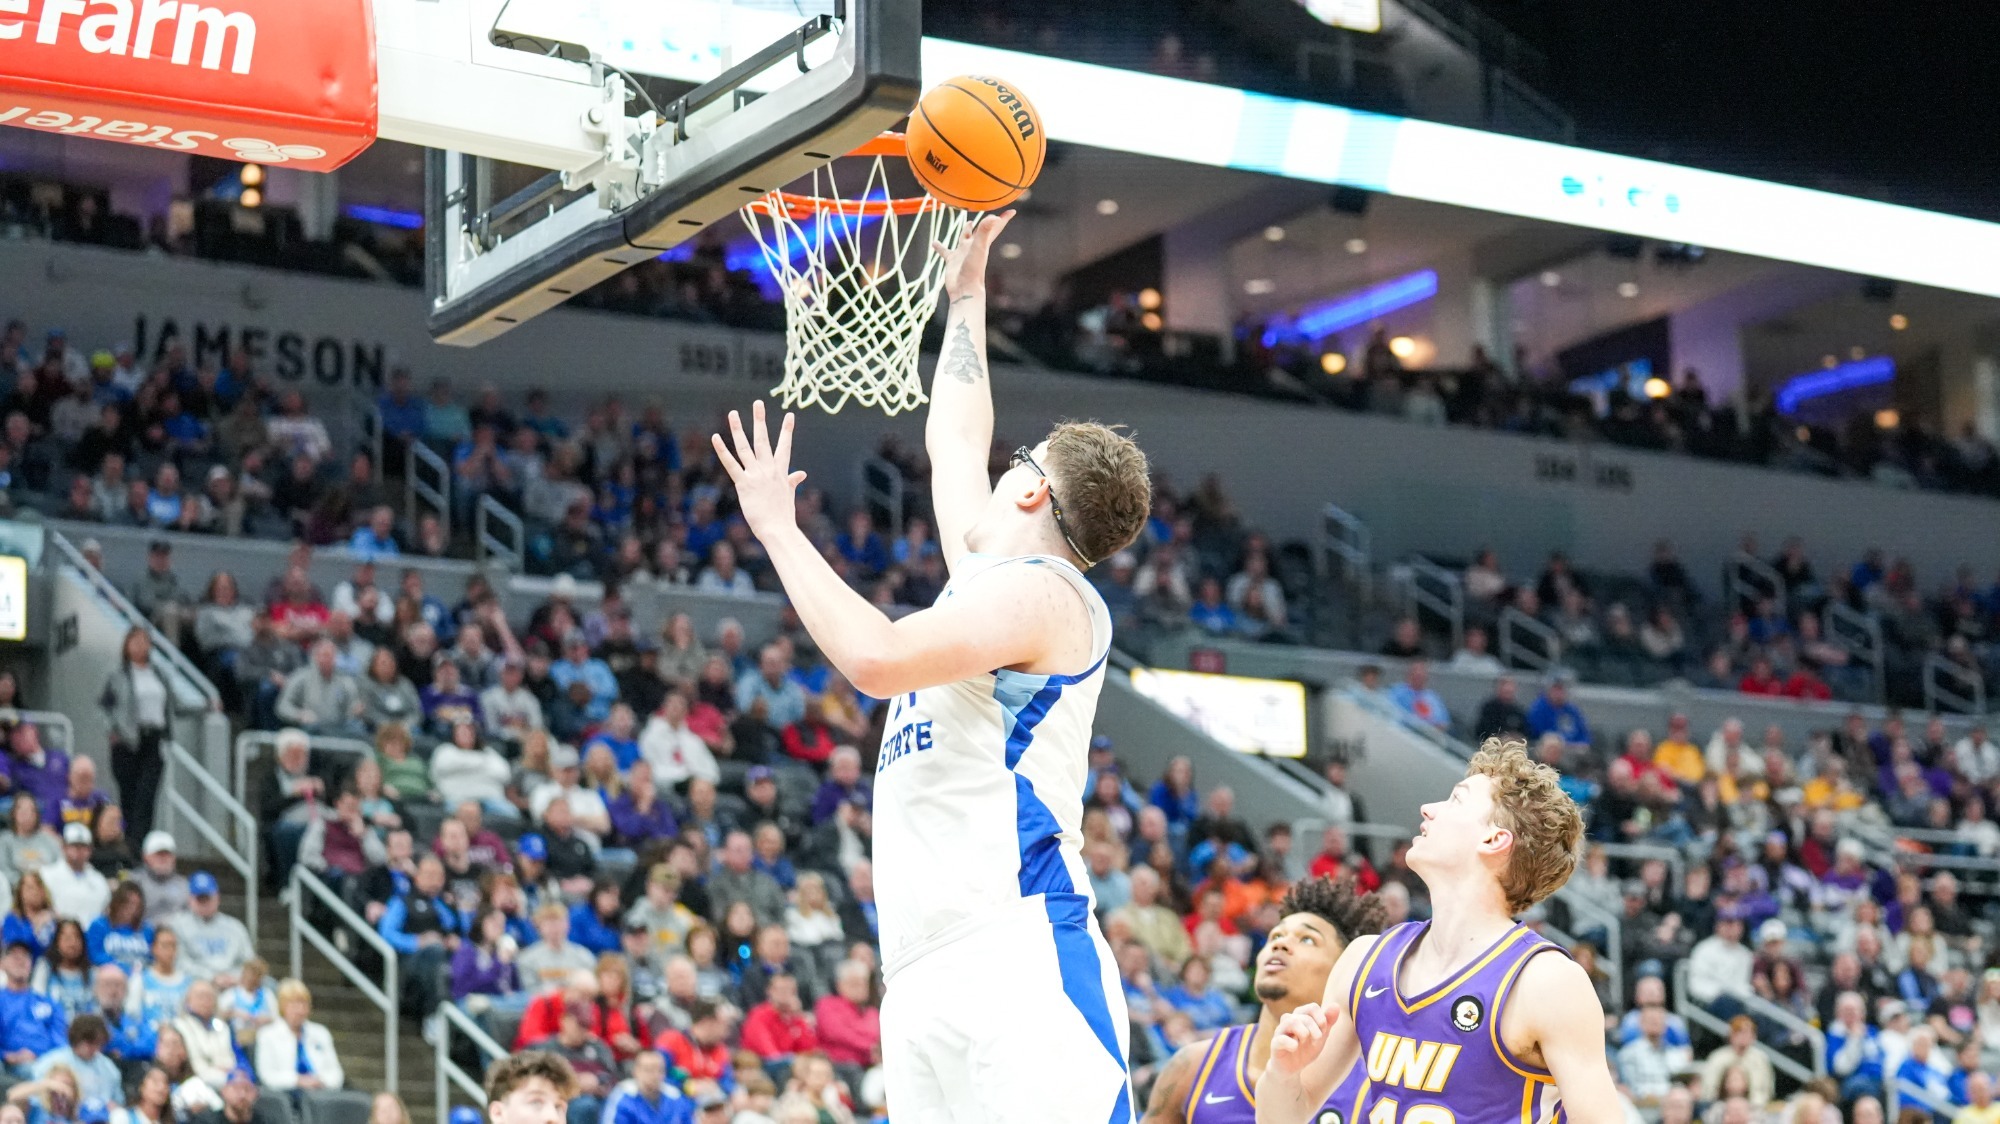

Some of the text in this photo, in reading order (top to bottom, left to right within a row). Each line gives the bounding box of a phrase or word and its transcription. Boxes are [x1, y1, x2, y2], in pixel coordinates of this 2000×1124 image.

[134, 313, 385, 388] JAMESON
[879, 720, 933, 773] STATE
[1367, 1031, 1462, 1093] UNI
